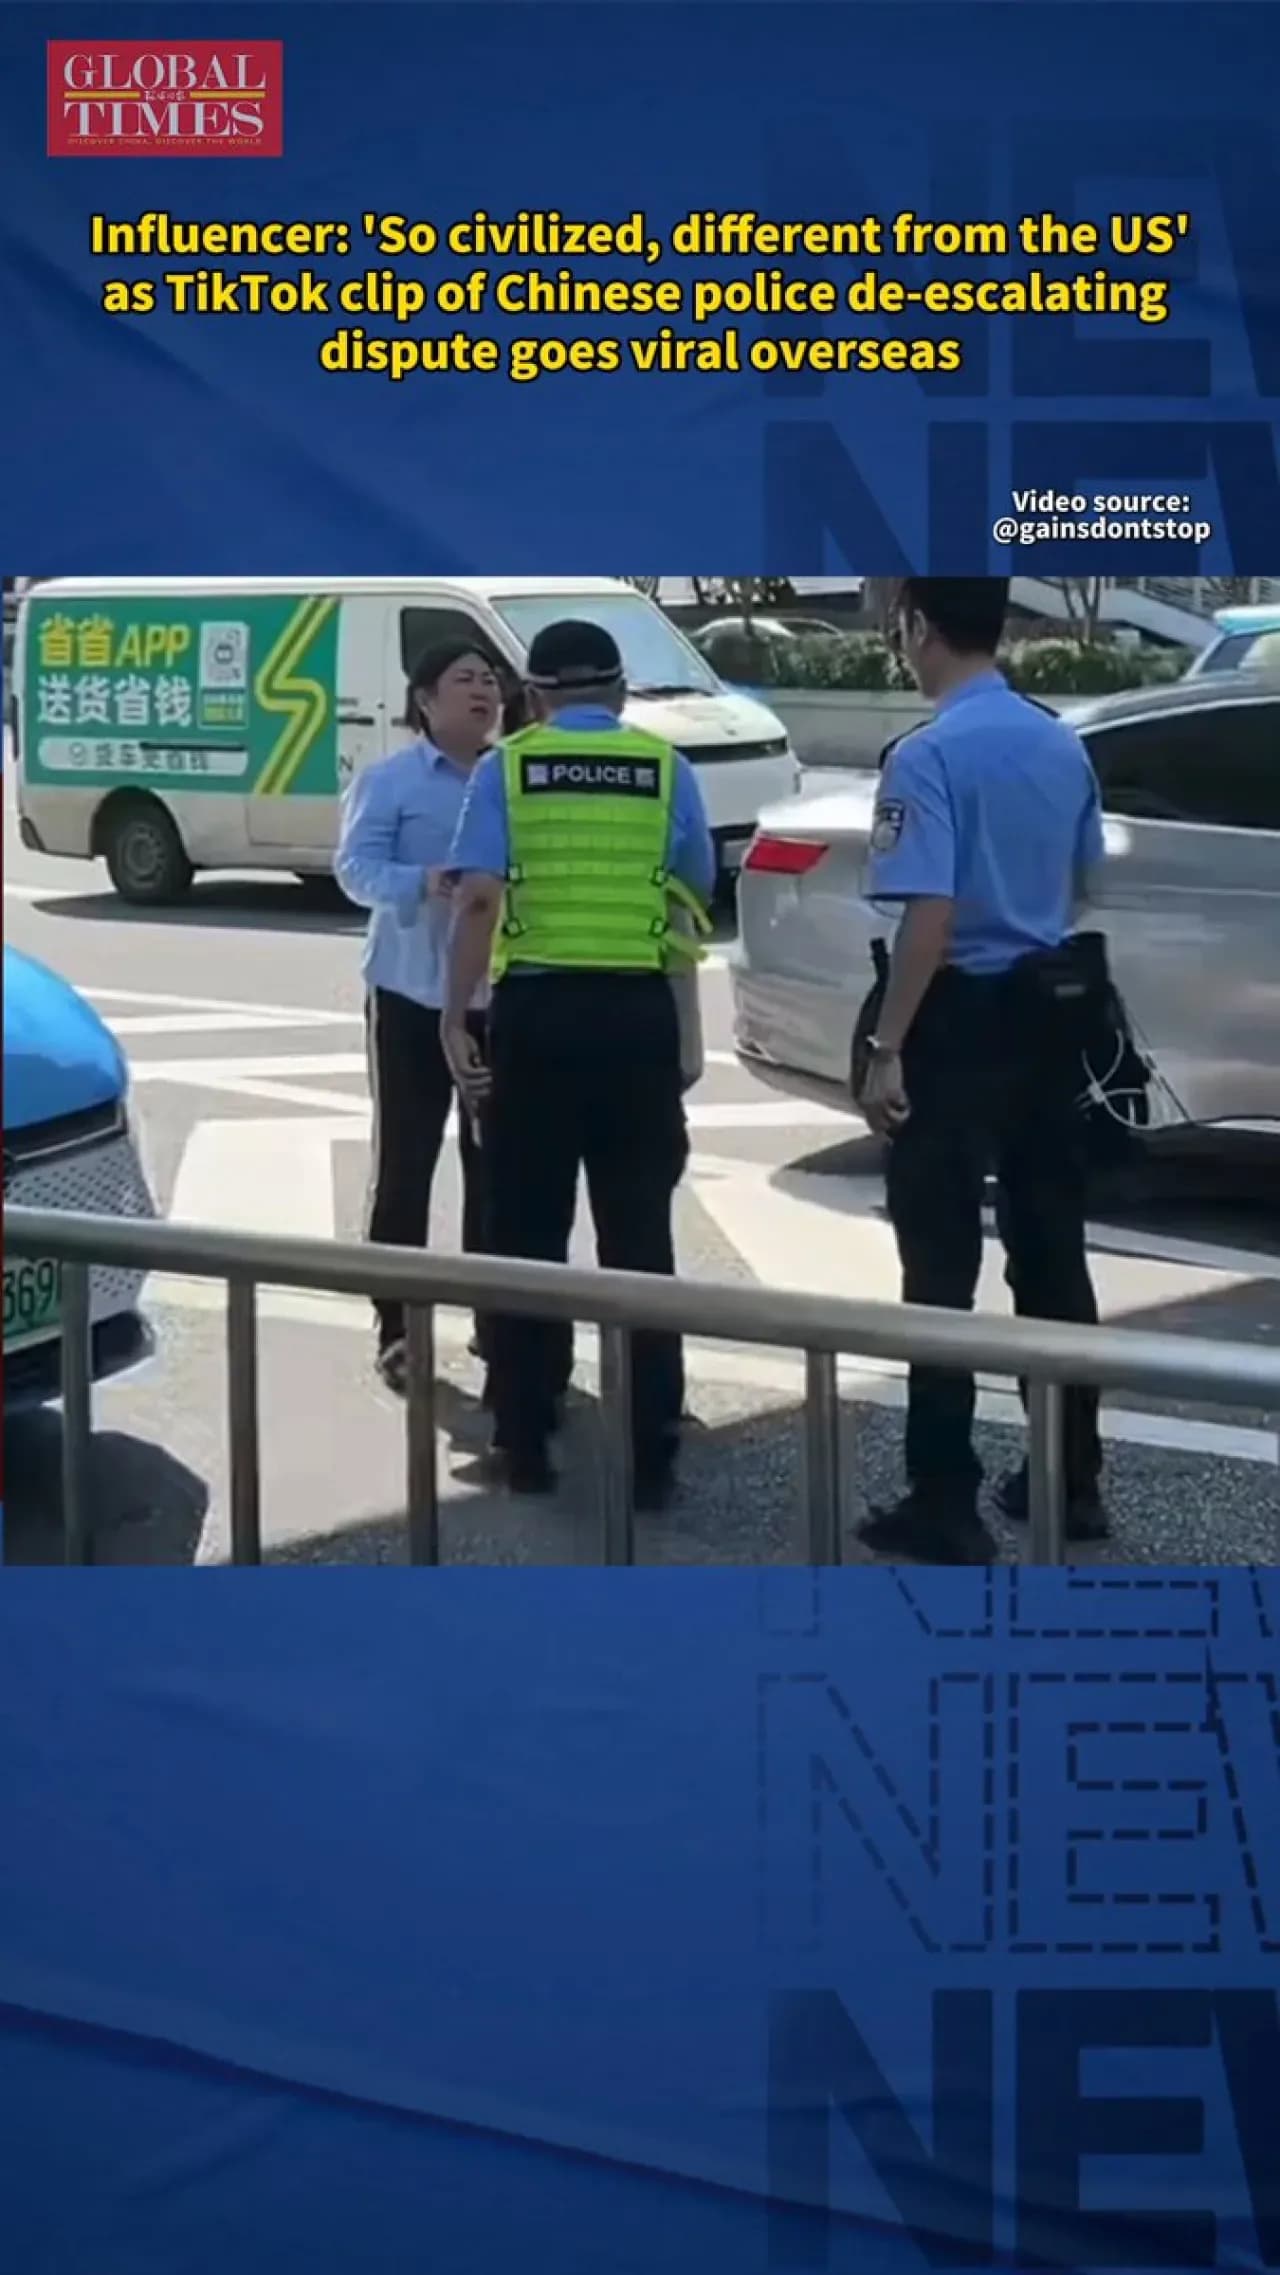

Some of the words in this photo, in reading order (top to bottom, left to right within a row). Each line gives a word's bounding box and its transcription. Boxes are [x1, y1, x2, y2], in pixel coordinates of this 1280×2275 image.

[38, 612, 190, 668] 省省APP
[37, 672, 192, 727] 送货省钱
[551, 763, 631, 784] POLICE
[3, 1257, 61, 1323] 369
